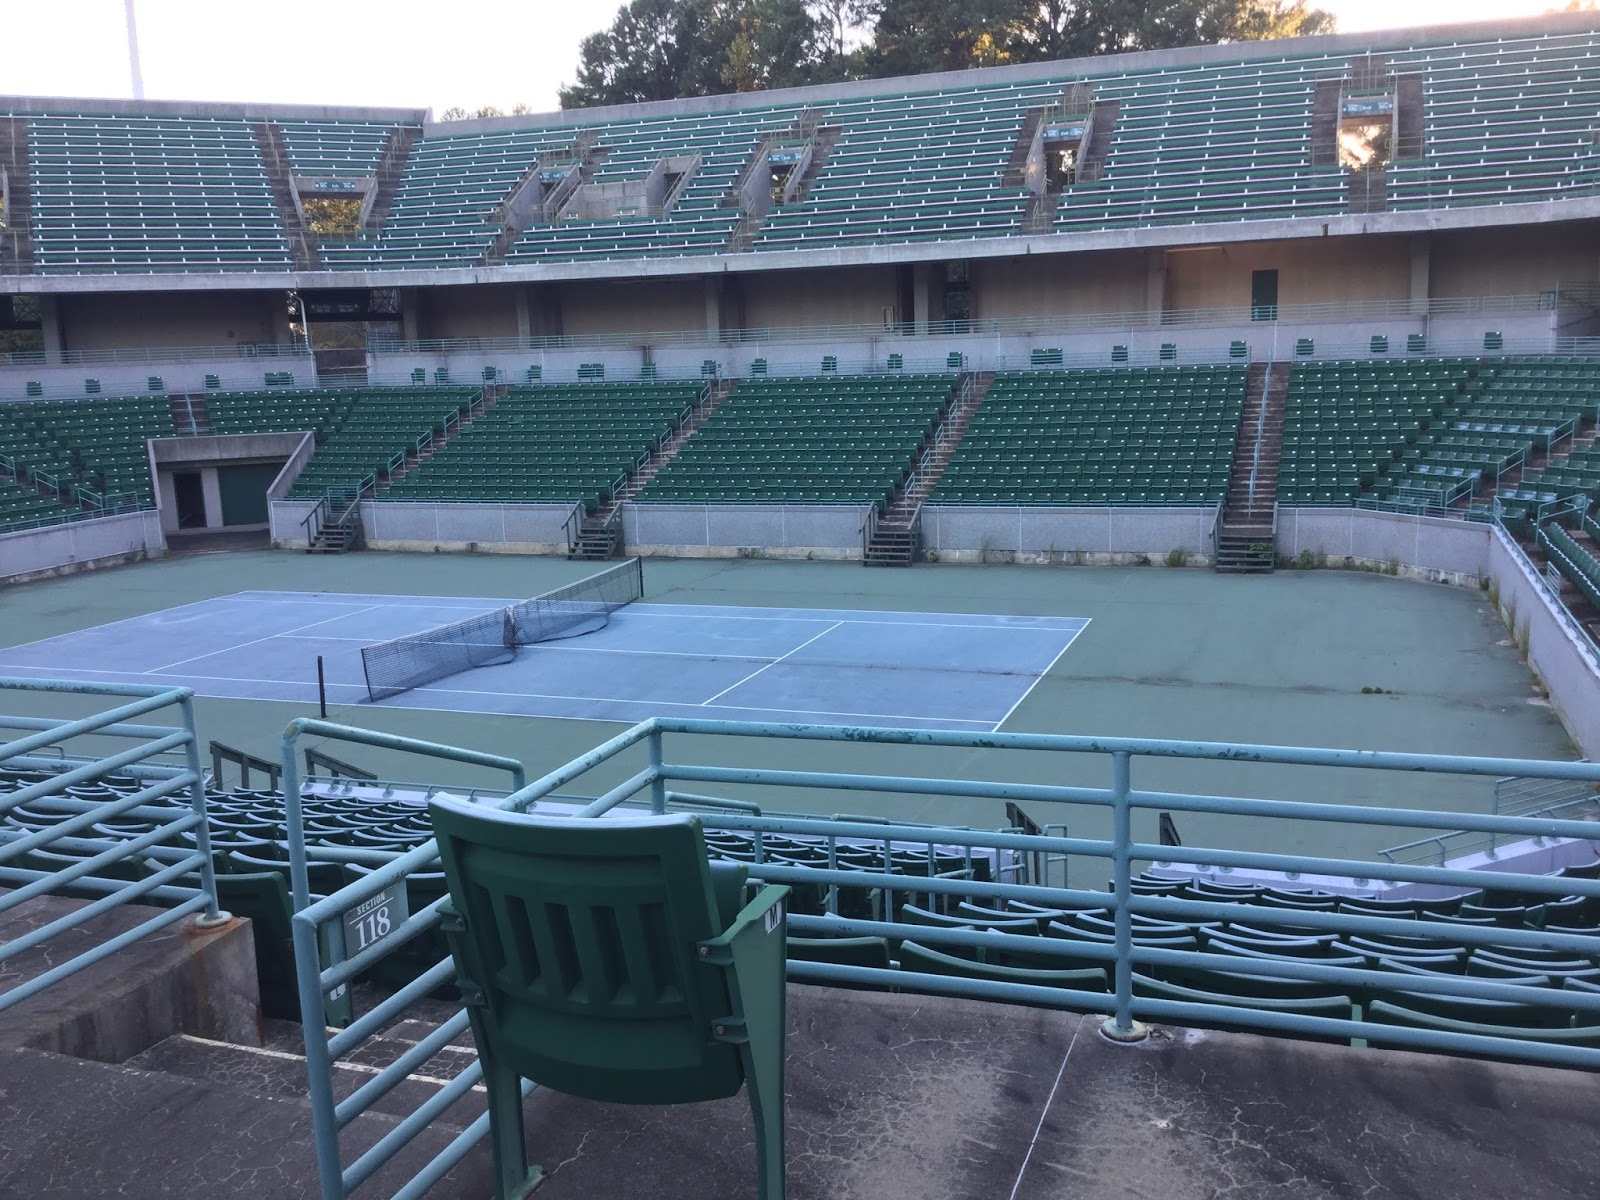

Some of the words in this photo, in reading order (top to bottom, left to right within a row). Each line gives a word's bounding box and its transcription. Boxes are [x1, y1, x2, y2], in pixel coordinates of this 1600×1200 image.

[356, 891, 386, 916] SECTION
[769, 903, 778, 930] M
[355, 906, 391, 950] 118
